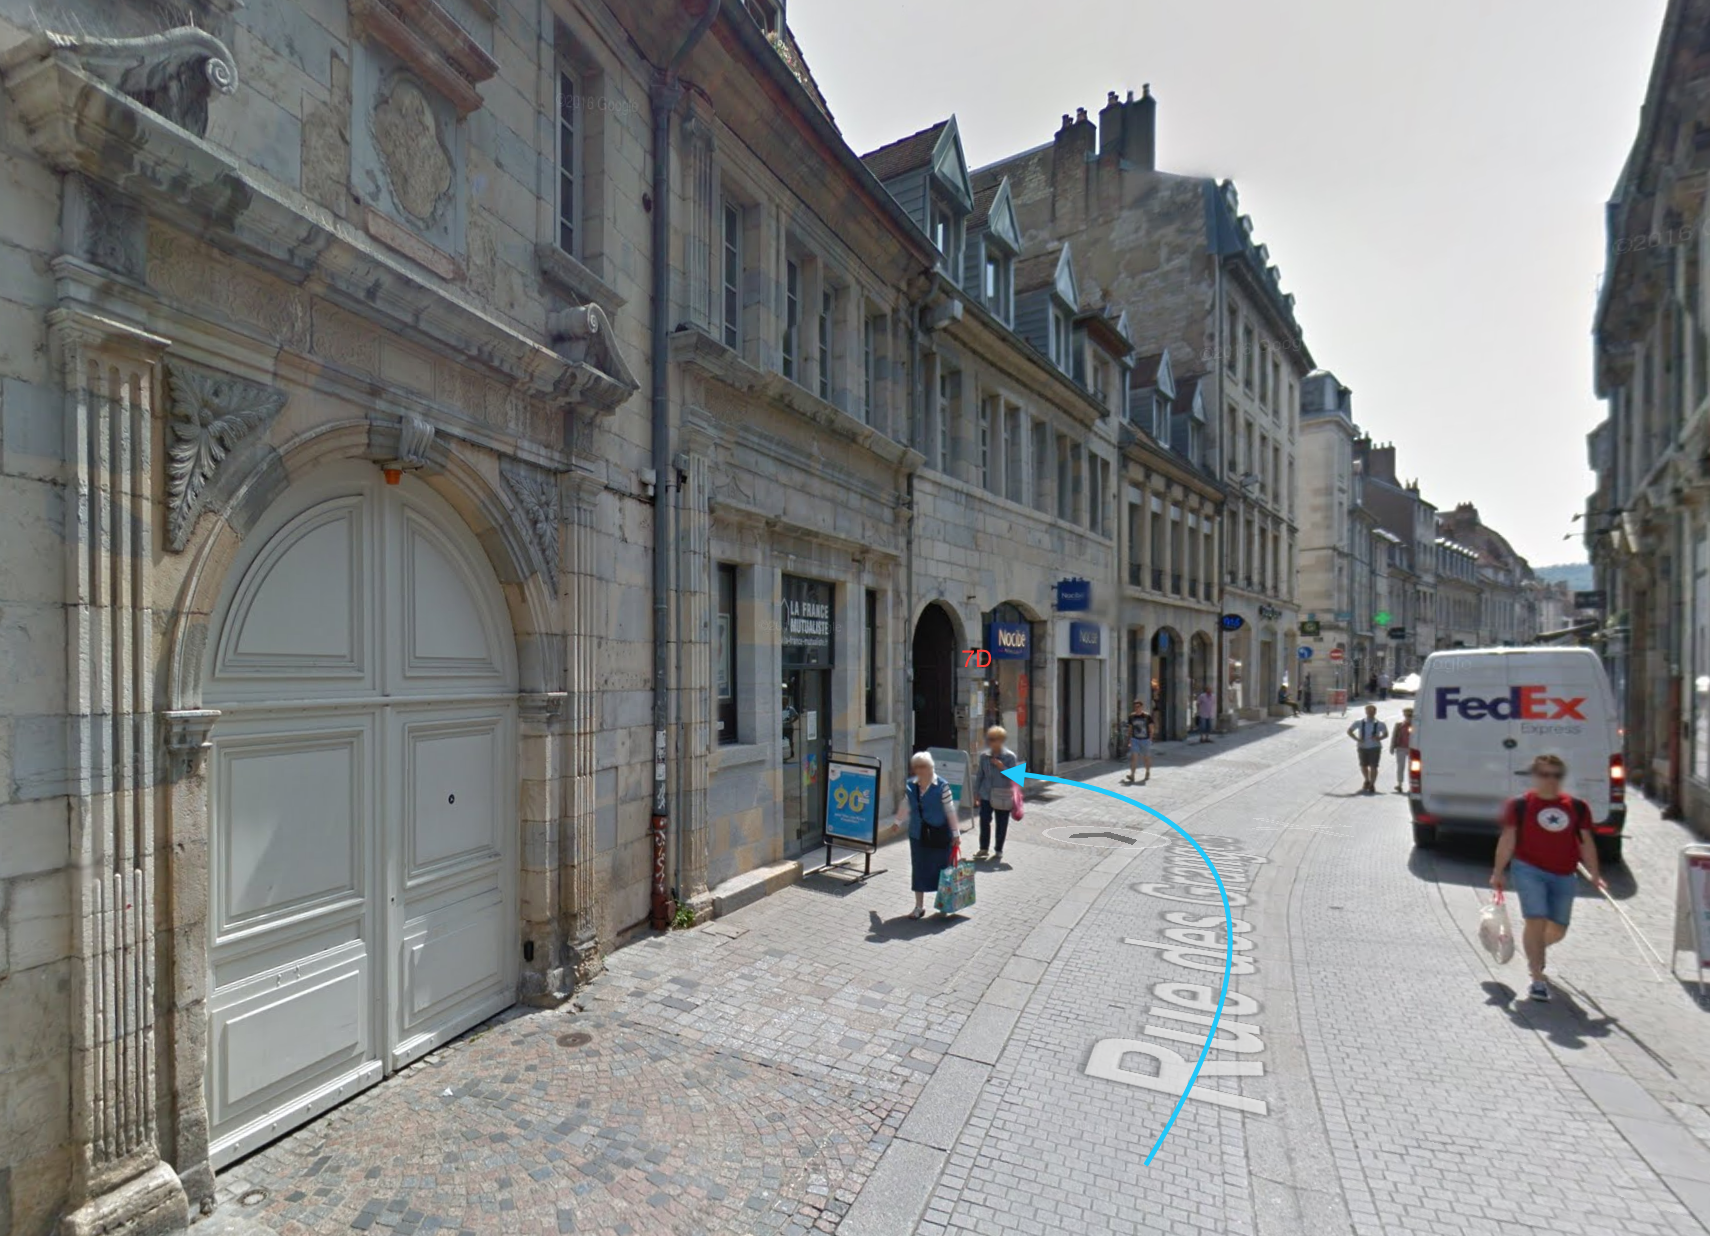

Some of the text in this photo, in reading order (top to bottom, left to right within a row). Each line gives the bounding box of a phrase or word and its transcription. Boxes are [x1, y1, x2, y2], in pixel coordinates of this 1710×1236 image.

[790, 600, 829, 619] LA FRANCE
[790, 618, 829, 635] MUTUALISTE
[1435, 685, 1588, 721] FedEx
[1521, 722, 1583, 736] Express
